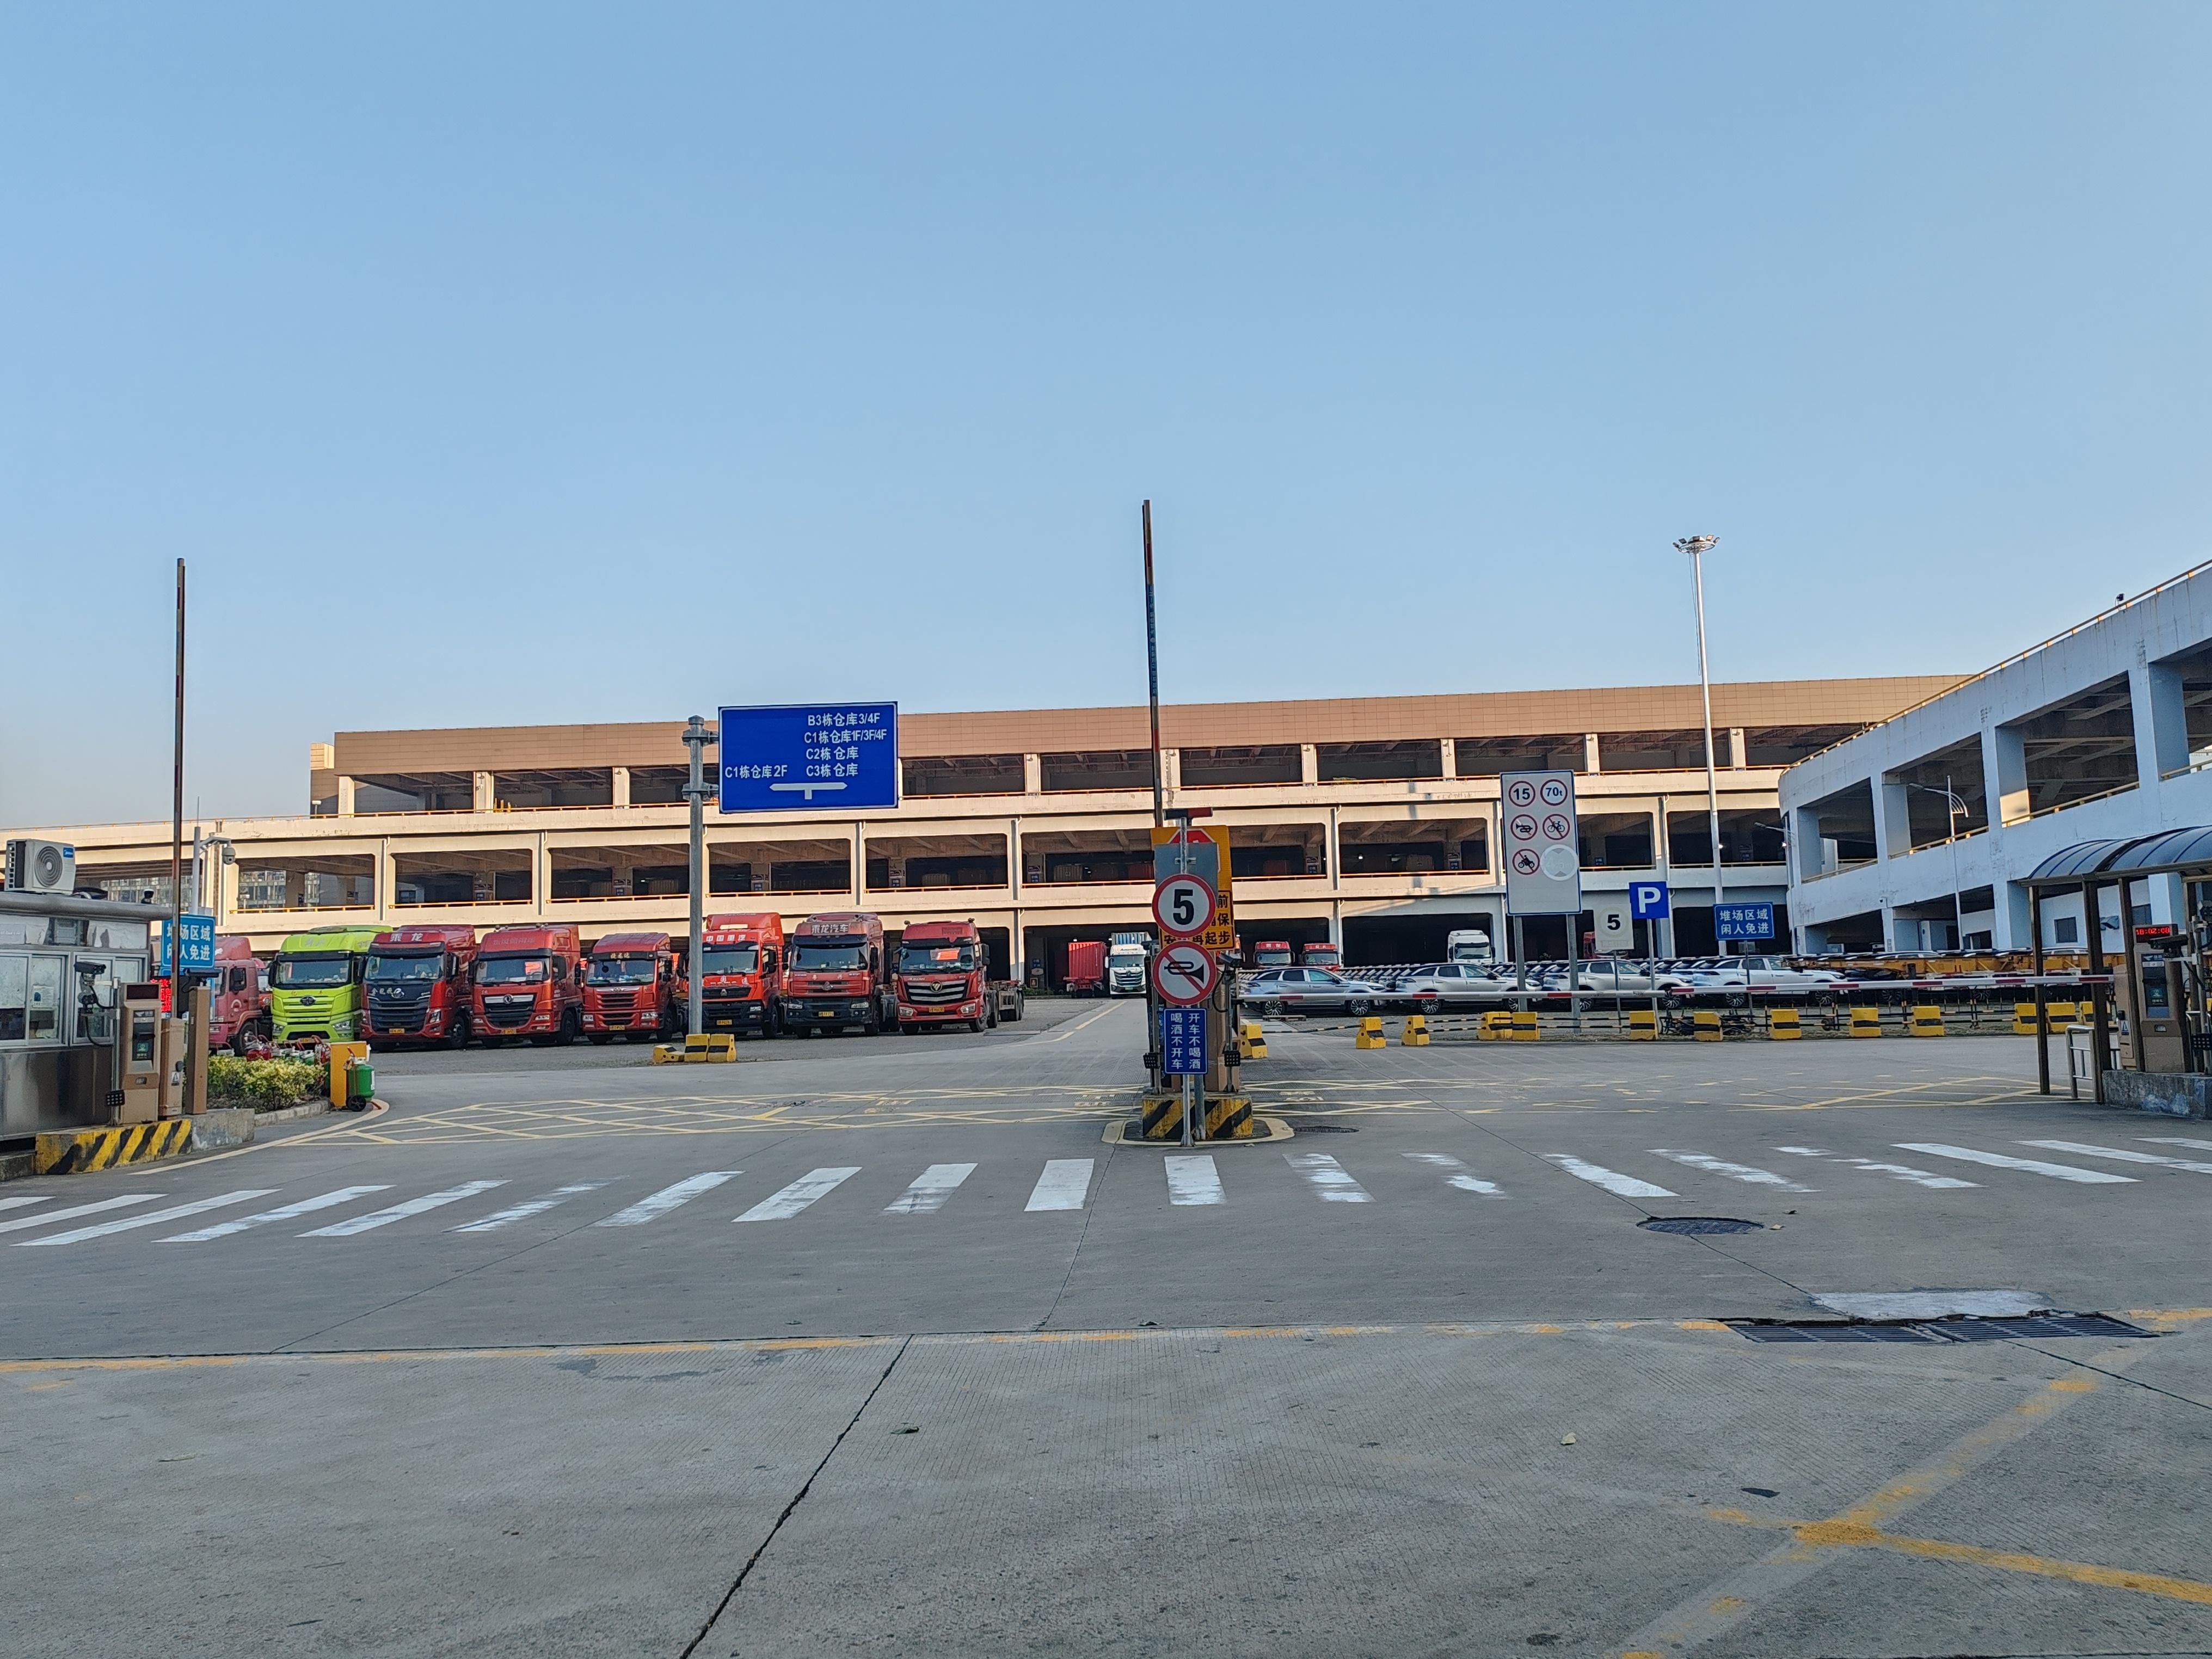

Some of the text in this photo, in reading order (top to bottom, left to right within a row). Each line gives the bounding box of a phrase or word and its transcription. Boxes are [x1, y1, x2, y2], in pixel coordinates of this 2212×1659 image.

[808, 712, 880, 727] B3栋仓库3/4F
[804, 729, 887, 744] C1栋仓库1F/3F/4F
[1513, 788, 1530, 800] 15
[1546, 787, 1563, 796] 70t
[1173, 889, 1194, 925] 5
[1638, 887, 1661, 913] P
[1607, 914, 1620, 930] 5
[1719, 908, 1768, 921] 堆场区域
[1721, 922, 1769, 935] 闲人免进
[1164, 931, 1230, 944] 安再起步
[1171, 1013, 1183, 1070] 喝酒不开车
[1188, 1013, 1201, 1070] 开车不喝酒
